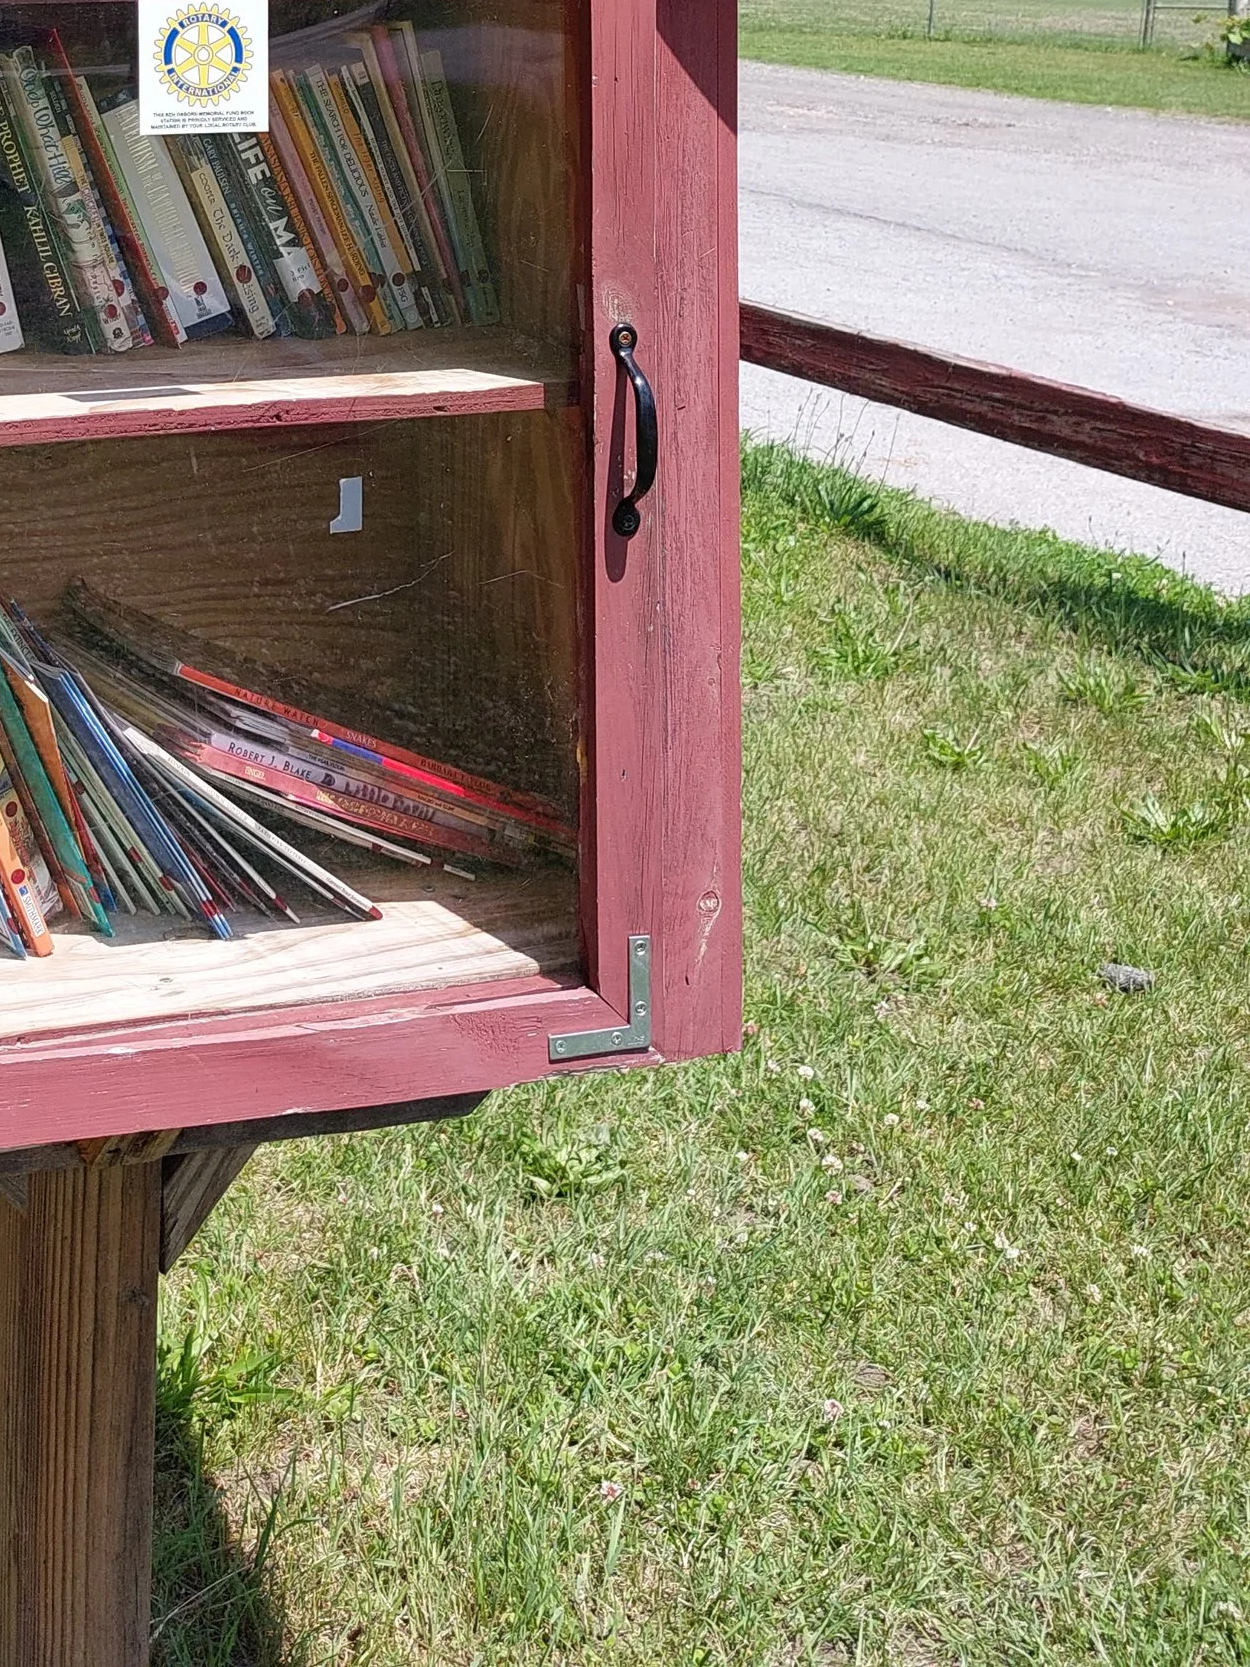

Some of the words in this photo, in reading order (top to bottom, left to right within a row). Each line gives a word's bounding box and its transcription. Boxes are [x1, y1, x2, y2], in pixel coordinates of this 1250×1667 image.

[183, 14, 225, 26] ROTARY
[17, 65, 49, 109] Over
[169, 67, 240, 97] INTERNATIONAL
[48, 89, 62, 113] SELDEN
[31, 103, 68, 153] What
[201, 136, 218, 160] GARY
[315, 78, 329, 98] THE
[323, 97, 343, 133] SEARCH
[335, 132, 349, 151] FOR
[343, 150, 368, 198] DELICIOUS
[363, 202, 379, 227] Natalie
[358, 150, 375, 176] Tiger
[77, 173, 86, 185] THE
[114, 104, 159, 174] CATECHISM
[145, 183, 187, 244] CATHOLIC
[209, 159, 233, 195] PAULSEN
[259, 135, 289, 193] ANASTASIA
[284, 191, 310, 243] KRUPNIK
[309, 150, 319, 165] THE
[314, 164, 330, 191] FALLEN
[324, 190, 345, 227] SPACEMAN
[78, 183, 101, 223] CRICKET
[261, 187, 283, 218] on
[385, 185, 393, 197] AND
[389, 197, 398, 211] THE
[96, 227, 107, 243] TIMES
[101, 242, 115, 264] SQUARE
[198, 171, 217, 205] COOPER
[210, 206, 228, 231] The
[220, 230, 241, 262] Dark
[231, 263, 261, 314] ising
[22, 201, 54, 262] KAHLIL
[41, 260, 73, 319] GIBRAN
[245, 241, 265, 275] WINTER
[233, 688, 277, 710] NATURE
[281, 706, 320, 726] WATCH
[343, 731, 379, 748] SNAKES
[226, 741, 265, 763] ROBERT
[268, 755, 280, 768] J.
[281, 759, 312, 779] BLAKE
[23, 896, 44, 934] SMITHMARK
